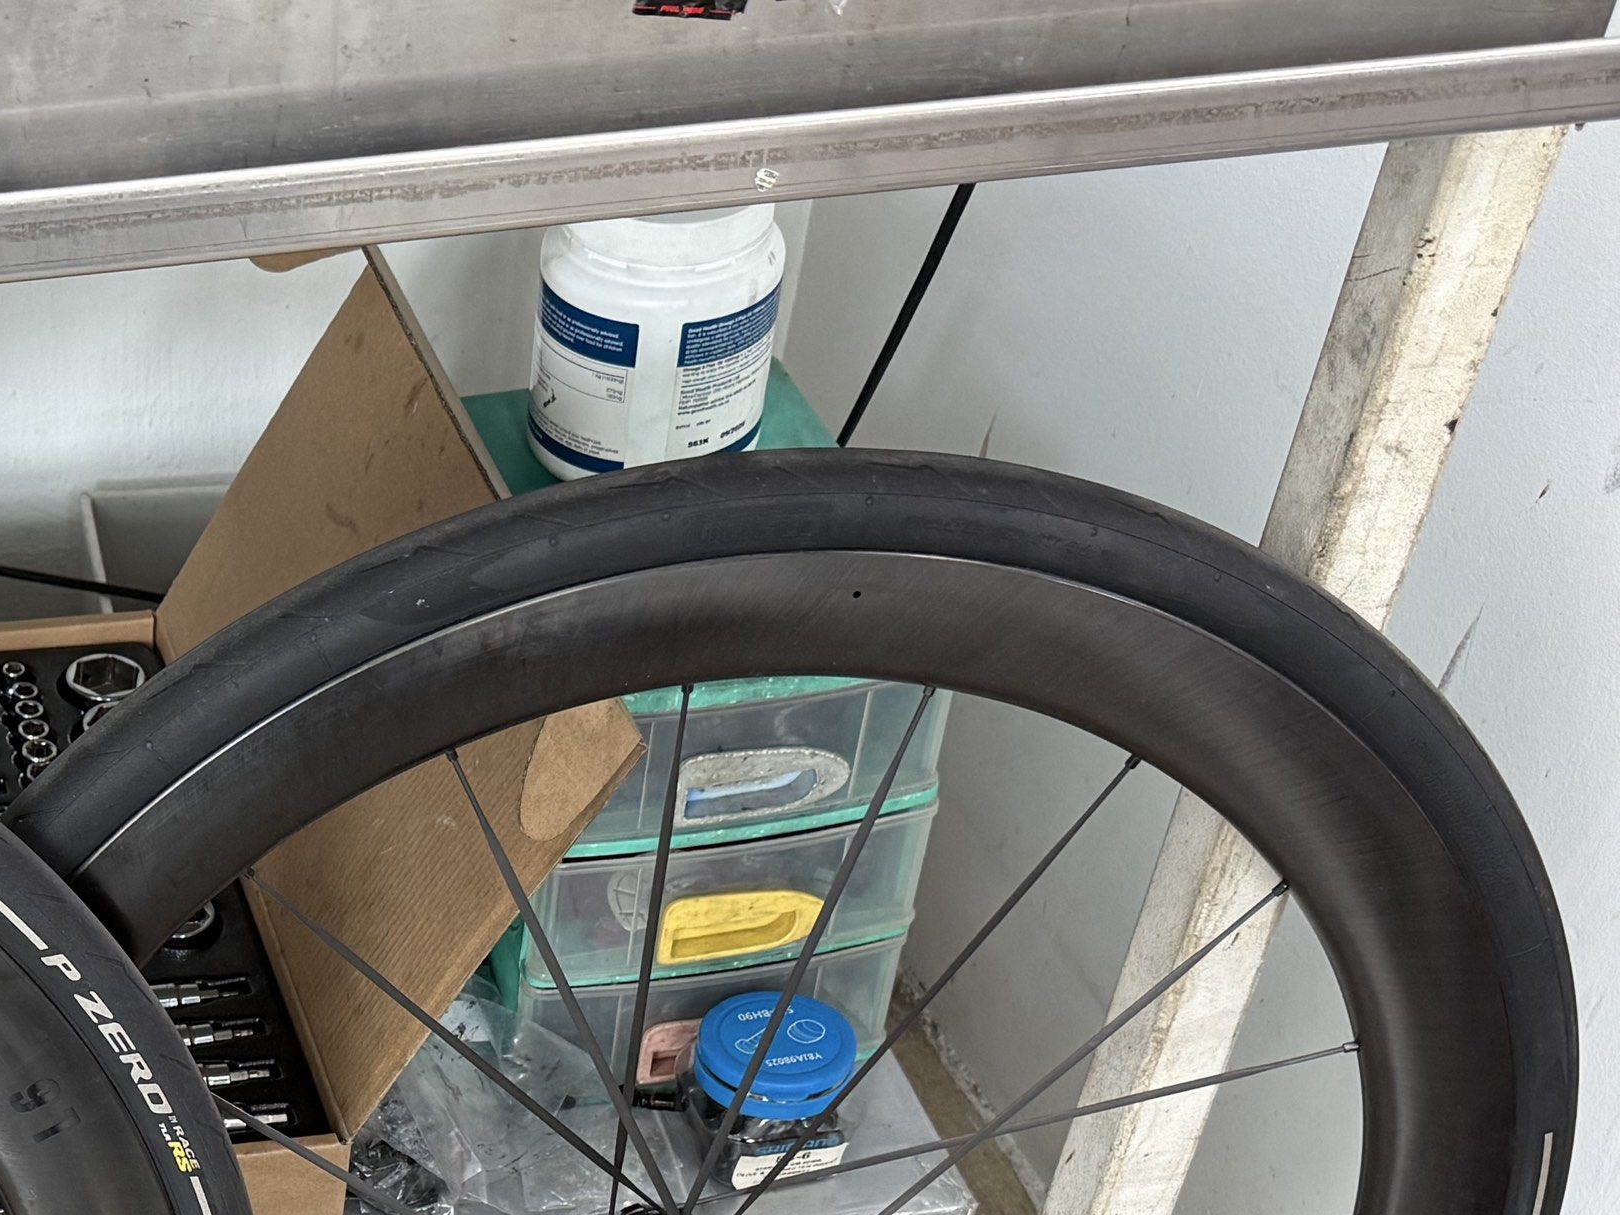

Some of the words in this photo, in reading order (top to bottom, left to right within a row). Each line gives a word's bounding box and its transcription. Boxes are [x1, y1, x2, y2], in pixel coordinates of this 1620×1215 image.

[40, 953, 82, 982] P
[73, 990, 173, 1114] ZERO
[167, 1141, 193, 1173] RS
